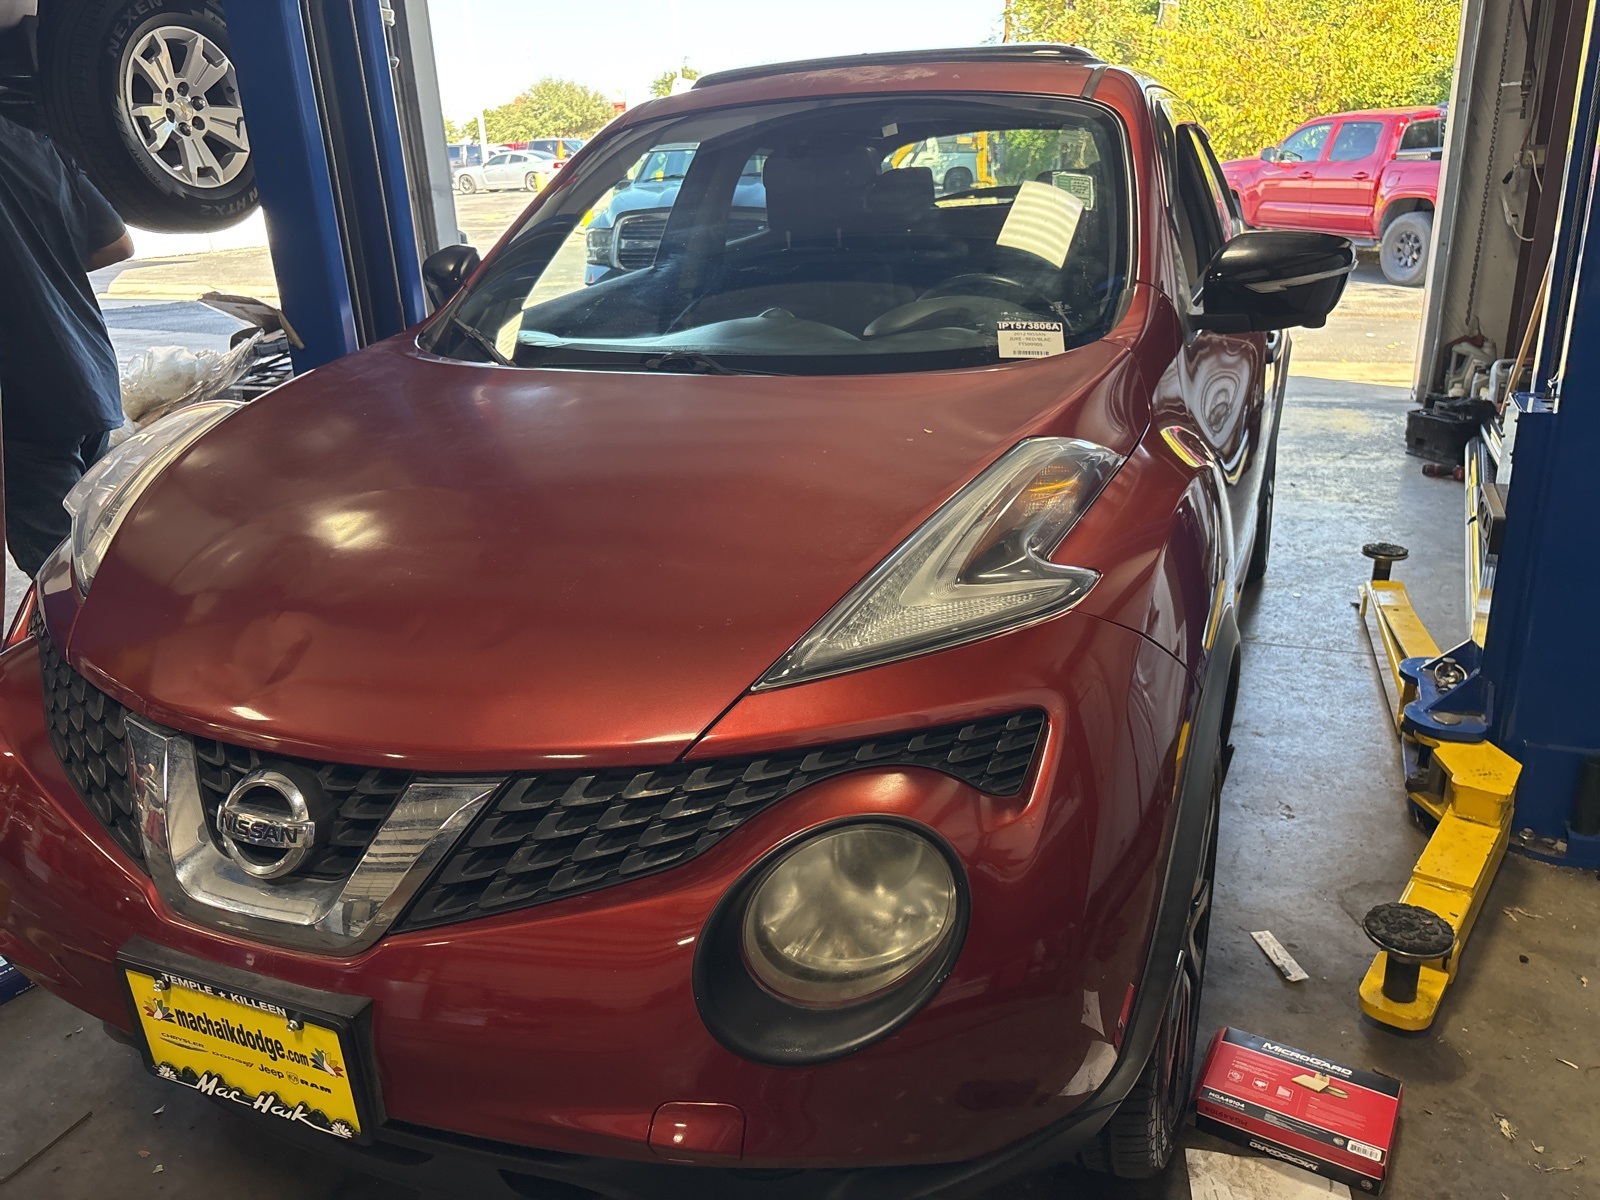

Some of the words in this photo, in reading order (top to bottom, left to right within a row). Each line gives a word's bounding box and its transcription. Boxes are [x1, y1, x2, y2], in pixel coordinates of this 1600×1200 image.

[109, 0, 163, 58] NEXEN
[221, 811, 298, 843] NISSAN
[161, 973, 213, 996] TEMPLE
[230, 993, 287, 1016] KILLEEN
[161, 1032, 205, 1048] CHRYSLER
[174, 1008, 310, 1066] machaikdodge.com
[212, 1051, 248, 1065] DODGE
[258, 1063, 284, 1079] Jeep
[196, 1074, 252, 1106] Mac
[300, 1079, 332, 1093] RAM
